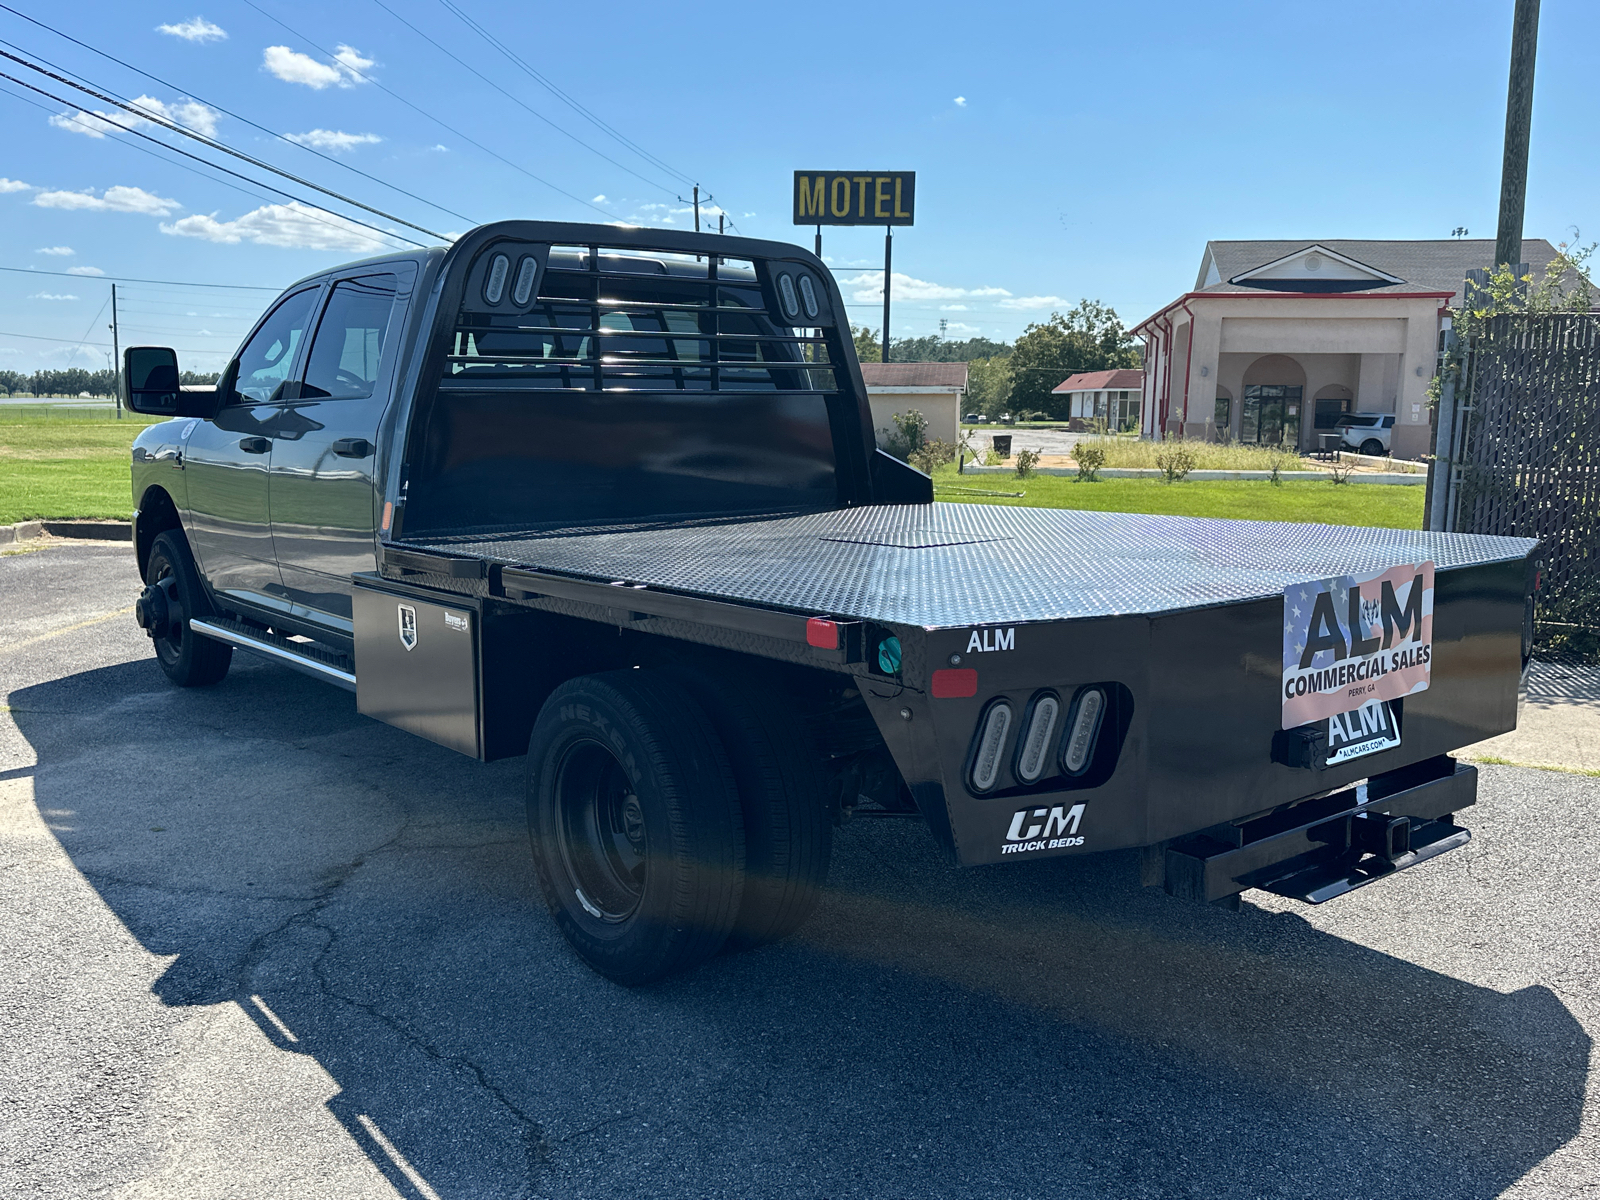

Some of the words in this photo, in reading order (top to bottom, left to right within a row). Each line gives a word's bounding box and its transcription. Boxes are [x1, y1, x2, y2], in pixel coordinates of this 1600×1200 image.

[798, 176, 911, 218] MOTEL
[966, 627, 1015, 653] ALM
[1298, 573, 1424, 671] ALM
[1284, 655, 1388, 699] COMMERCIAL
[1391, 644, 1431, 672] SALES
[1348, 686, 1367, 698] PERRY,
[1367, 683, 1376, 693] GA
[559, 703, 643, 784] NEXEN
[1328, 703, 1387, 747] ALM
[1005, 802, 1087, 841] CM
[1001, 841, 1047, 855] TRUCK
[1047, 836, 1085, 850] BEDS
